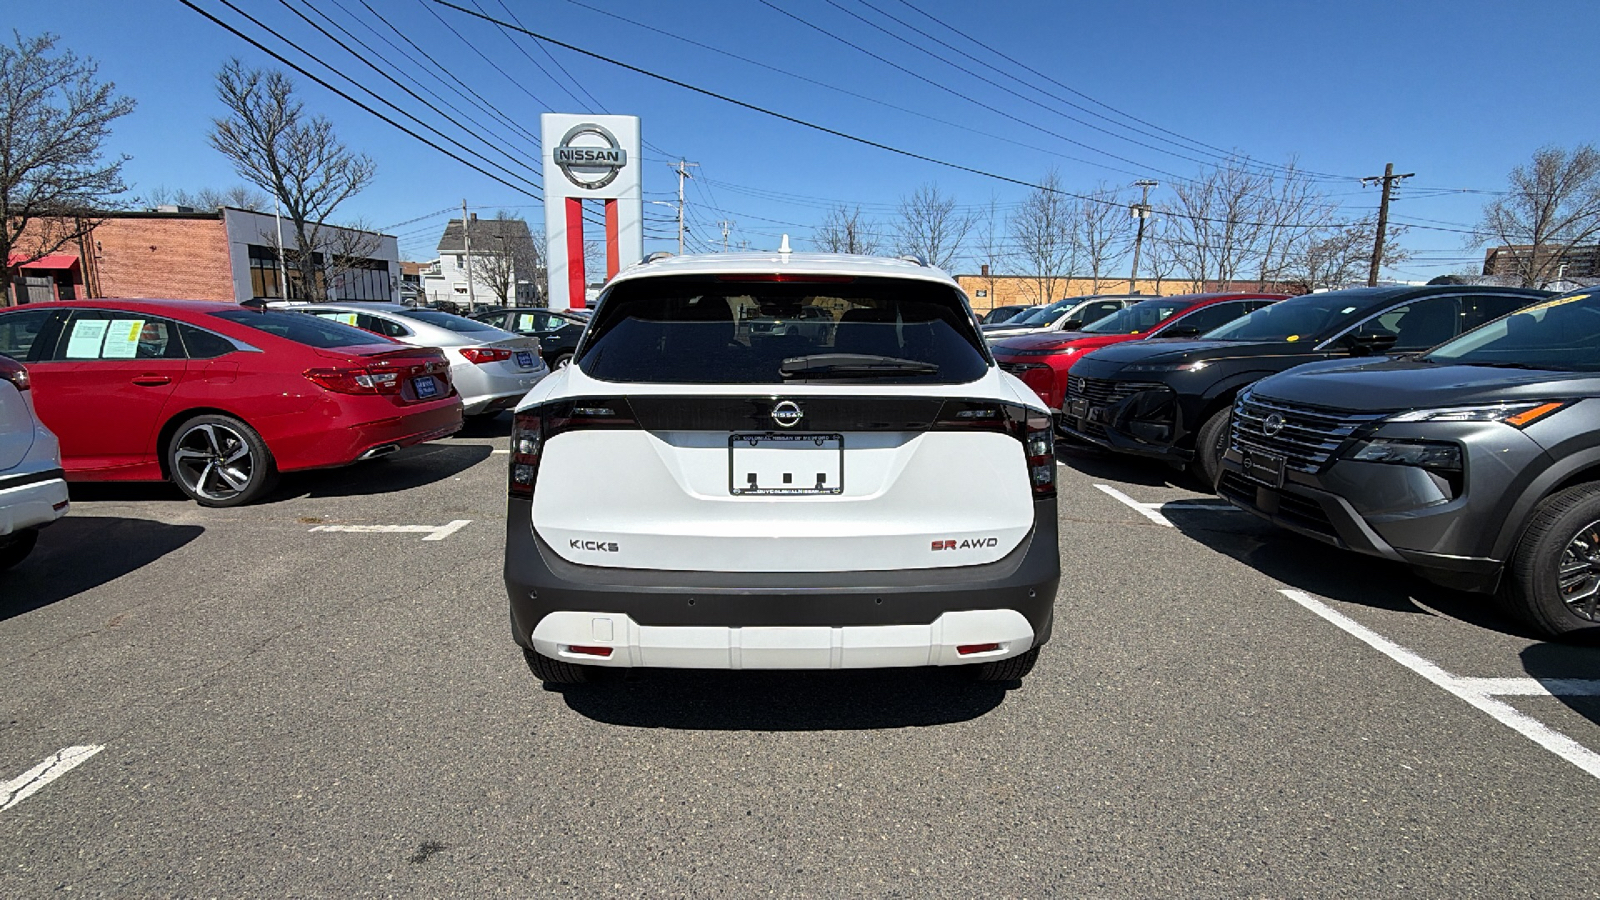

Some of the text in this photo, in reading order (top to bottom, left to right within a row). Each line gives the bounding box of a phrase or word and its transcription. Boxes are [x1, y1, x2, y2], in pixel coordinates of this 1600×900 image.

[559, 149, 619, 162] NISSAN
[569, 539, 619, 552] KICKS
[931, 537, 998, 551] SR AWD
